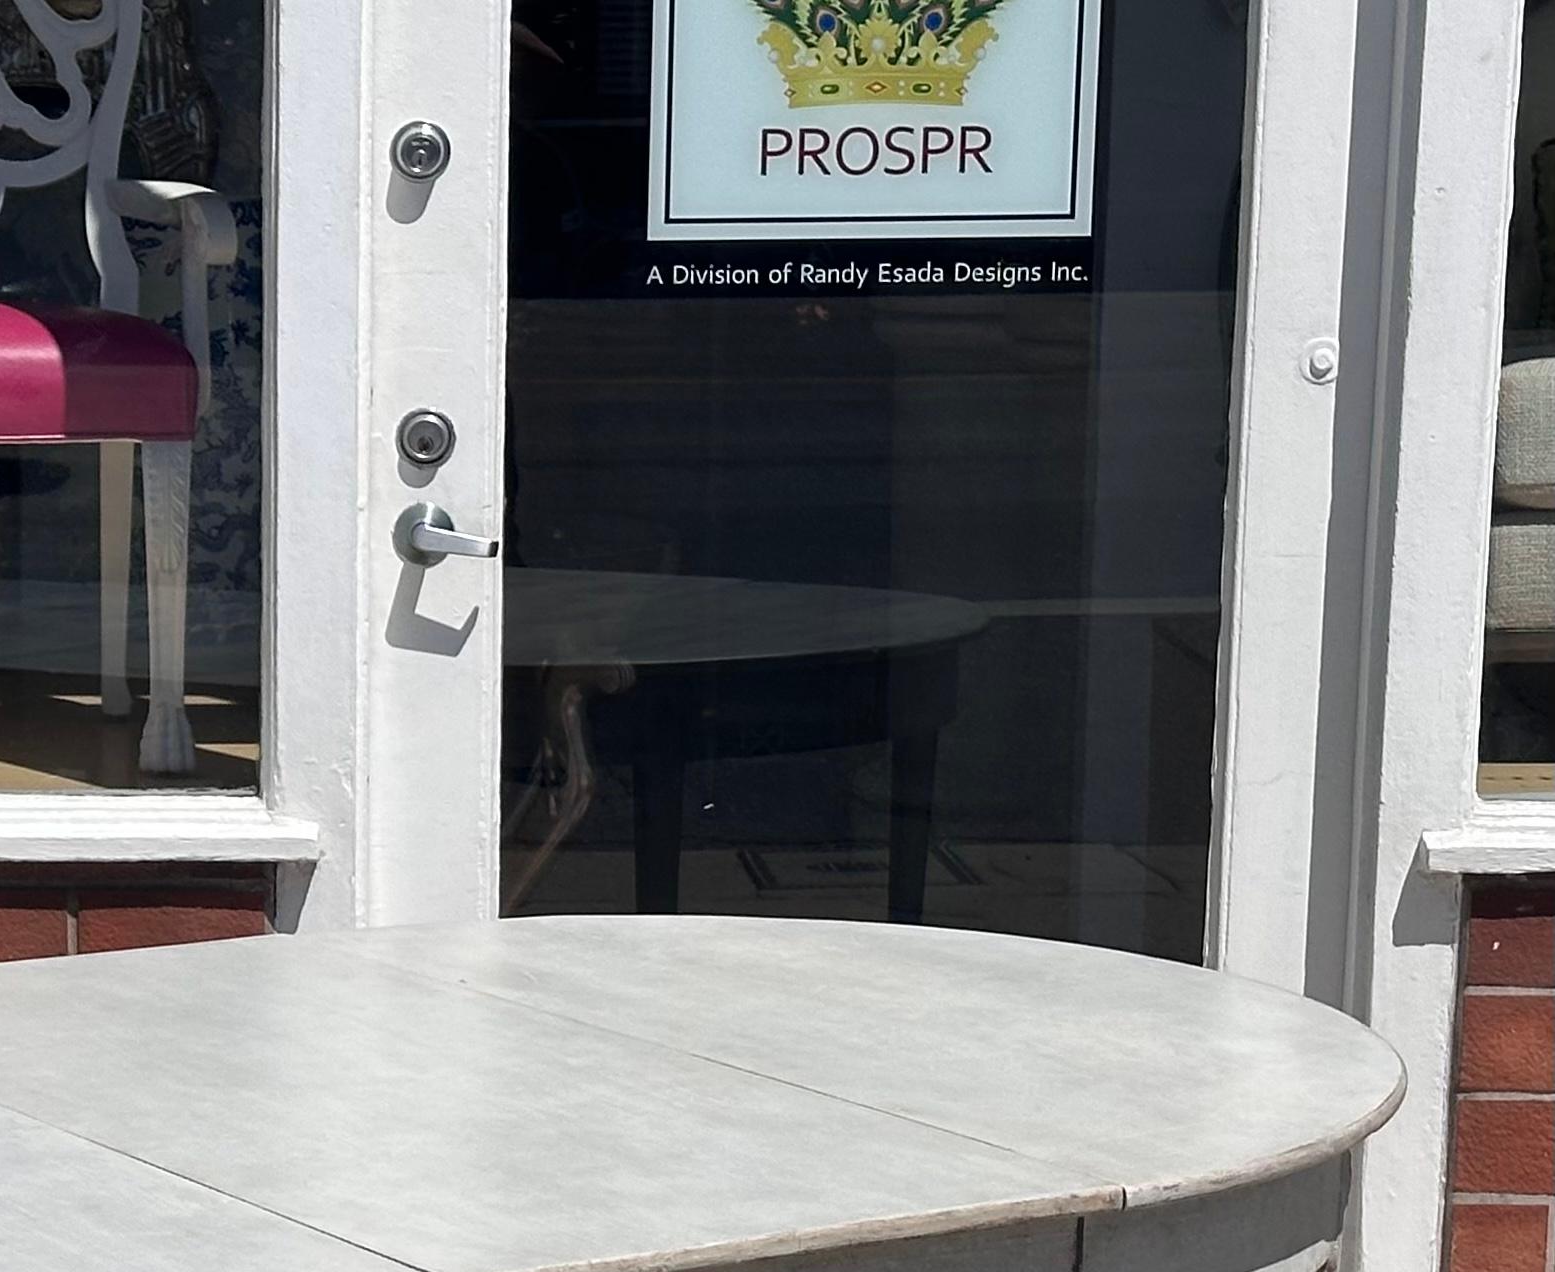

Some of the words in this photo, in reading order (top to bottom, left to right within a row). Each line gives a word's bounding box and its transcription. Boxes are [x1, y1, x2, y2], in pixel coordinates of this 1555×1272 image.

[760, 125, 993, 176] PROSPR
[646, 265, 664, 285] A
[672, 263, 759, 285] Division
[768, 261, 794, 285] of
[800, 261, 869, 290] Randy
[878, 261, 944, 285] Esada
[954, 261, 1042, 289] Designs
[1051, 261, 1089, 283] Inc.
